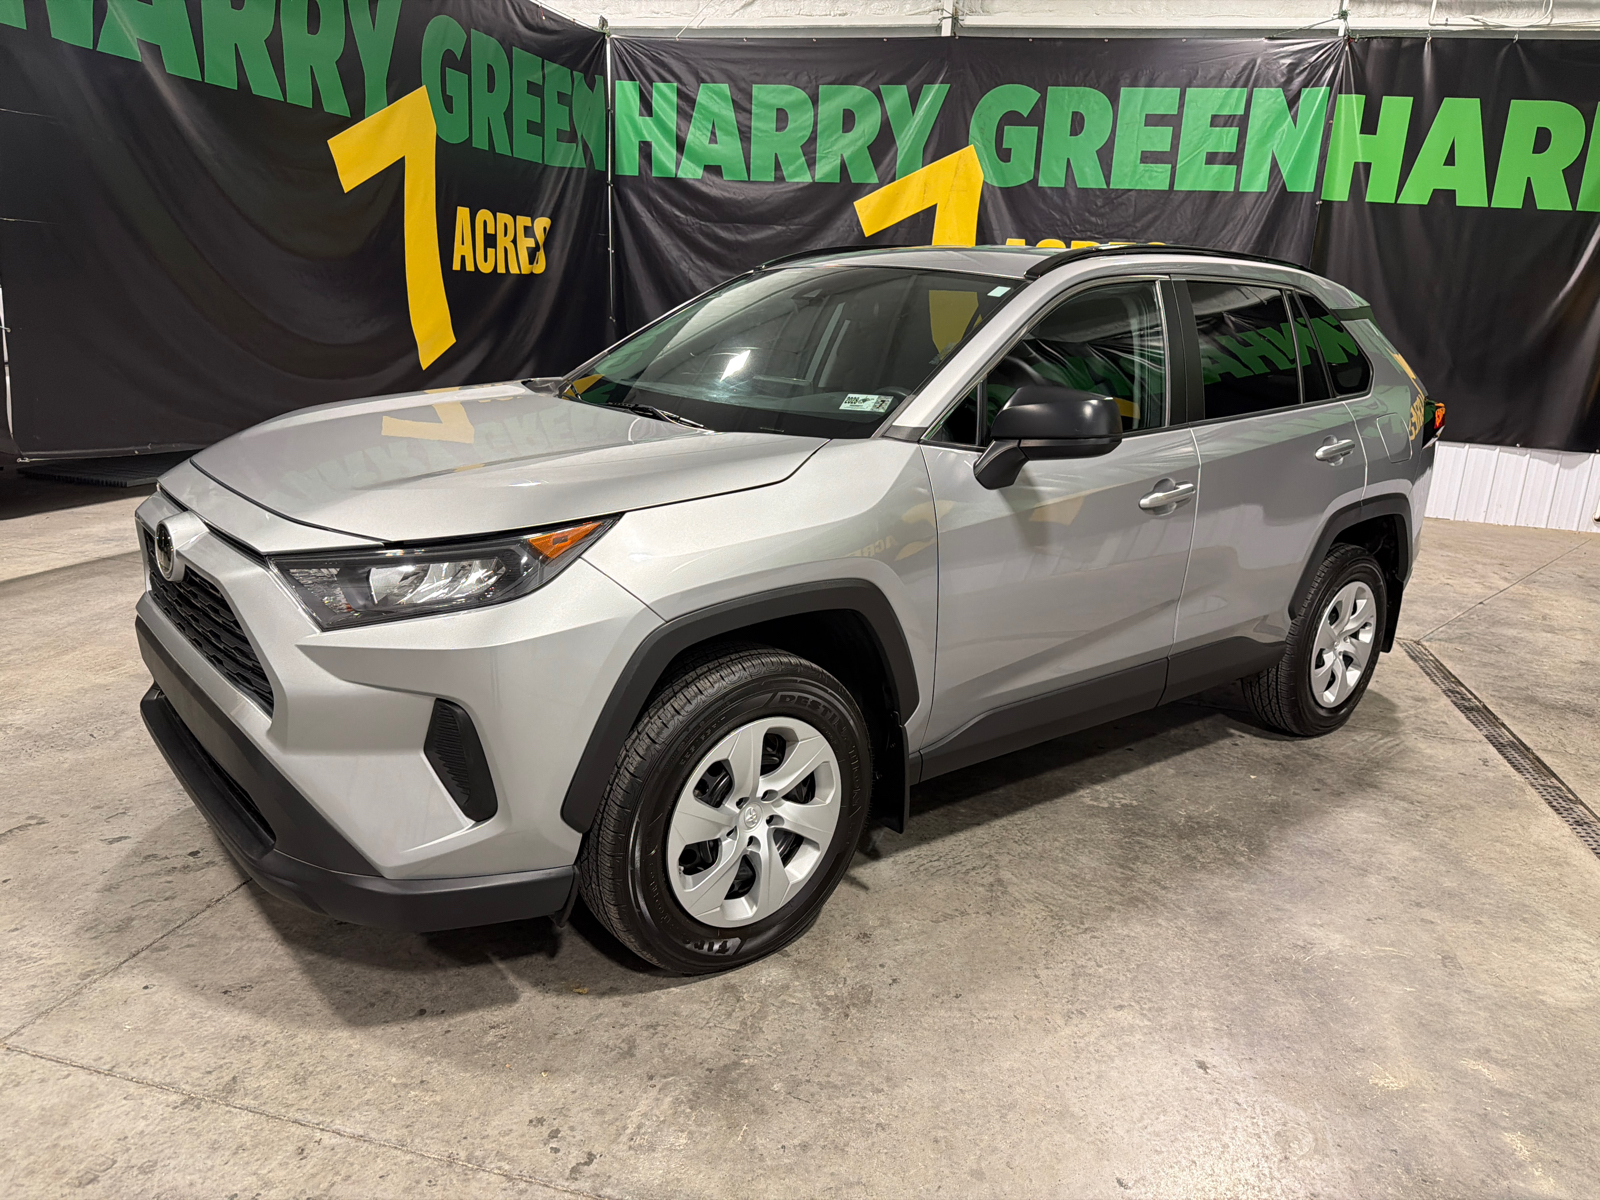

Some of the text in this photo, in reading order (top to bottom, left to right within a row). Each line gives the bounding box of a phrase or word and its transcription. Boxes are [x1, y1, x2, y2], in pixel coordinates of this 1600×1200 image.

[422, 15, 606, 171] GREEN
[615, 80, 1330, 192] HARRY GREEN
[1321, 94, 1600, 212] HAR
[328, 86, 551, 370] 7 ACRES
